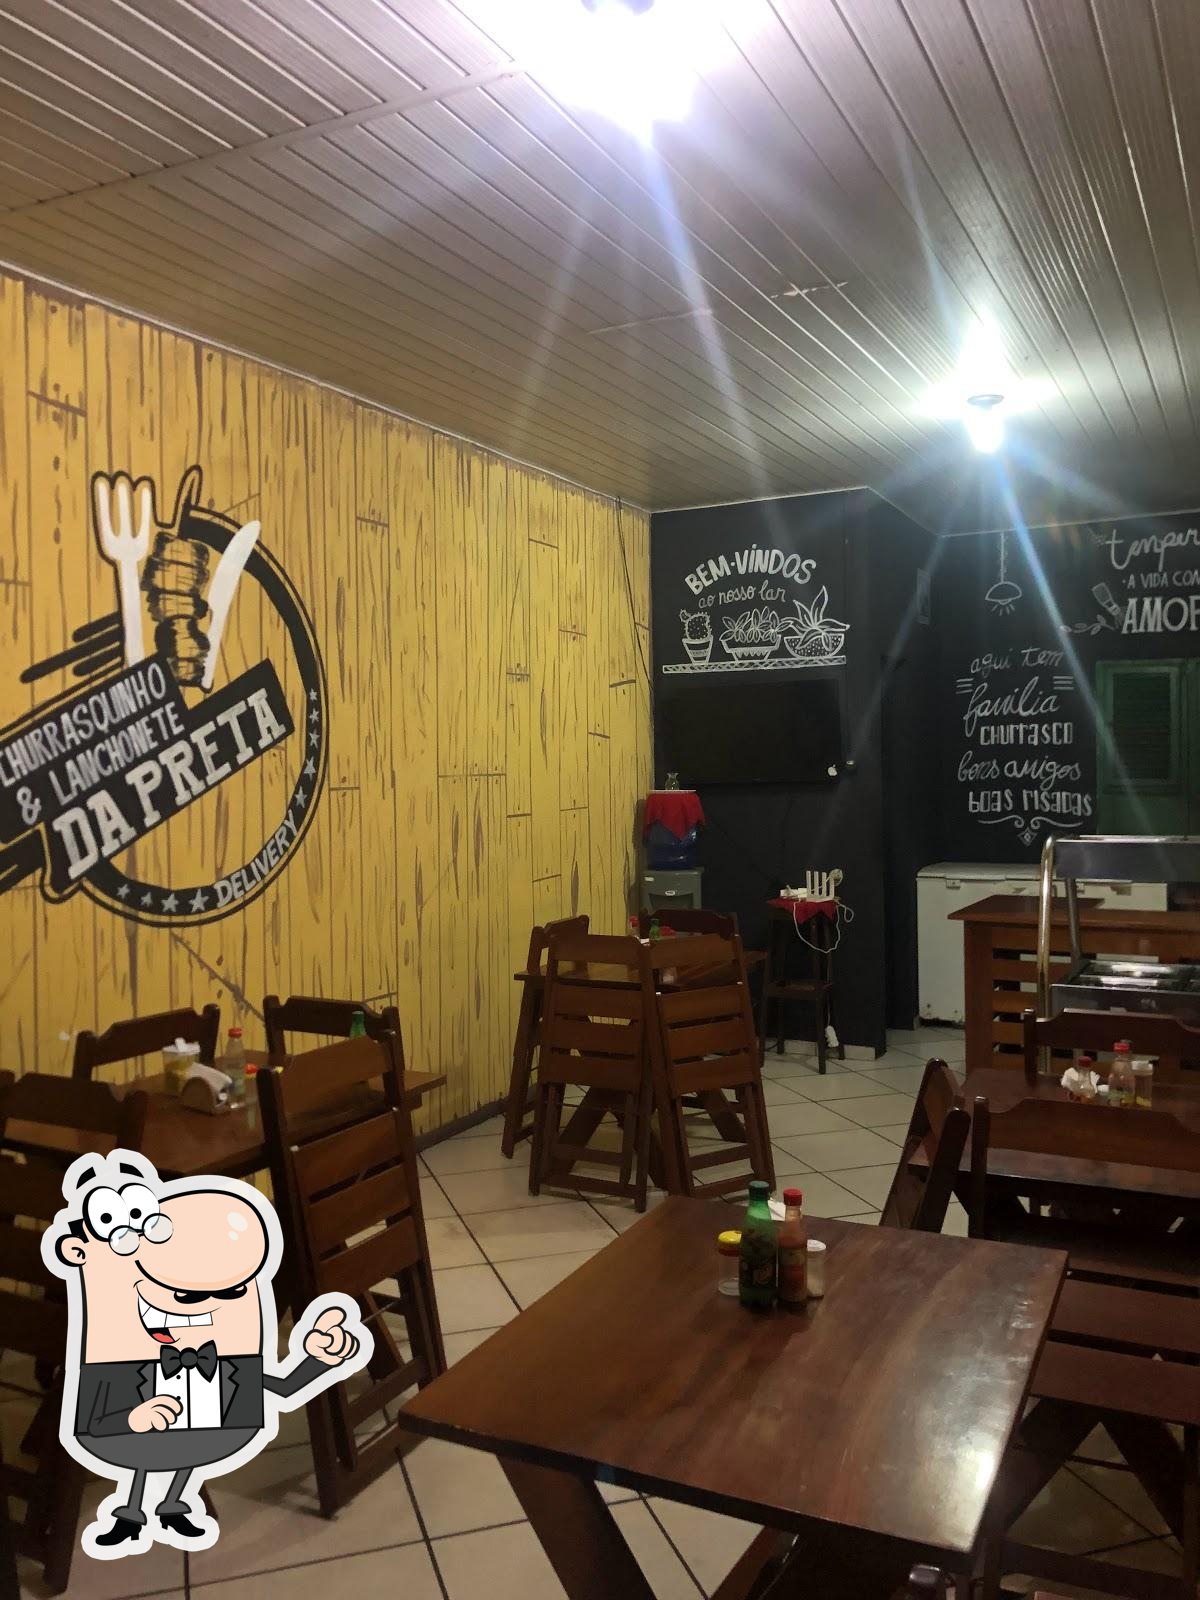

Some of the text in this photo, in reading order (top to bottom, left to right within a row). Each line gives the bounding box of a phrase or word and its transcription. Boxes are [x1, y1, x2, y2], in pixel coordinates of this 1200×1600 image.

[698, 580, 787, 609] ao nosso lar
[1141, 572, 1168, 589] VIDA
[16, 701, 185, 825] & LANCHONETE
[51, 687, 286, 880] DA PRETA
[1004, 755, 1081, 791] amigos
[213, 810, 299, 909] DELIVERY
